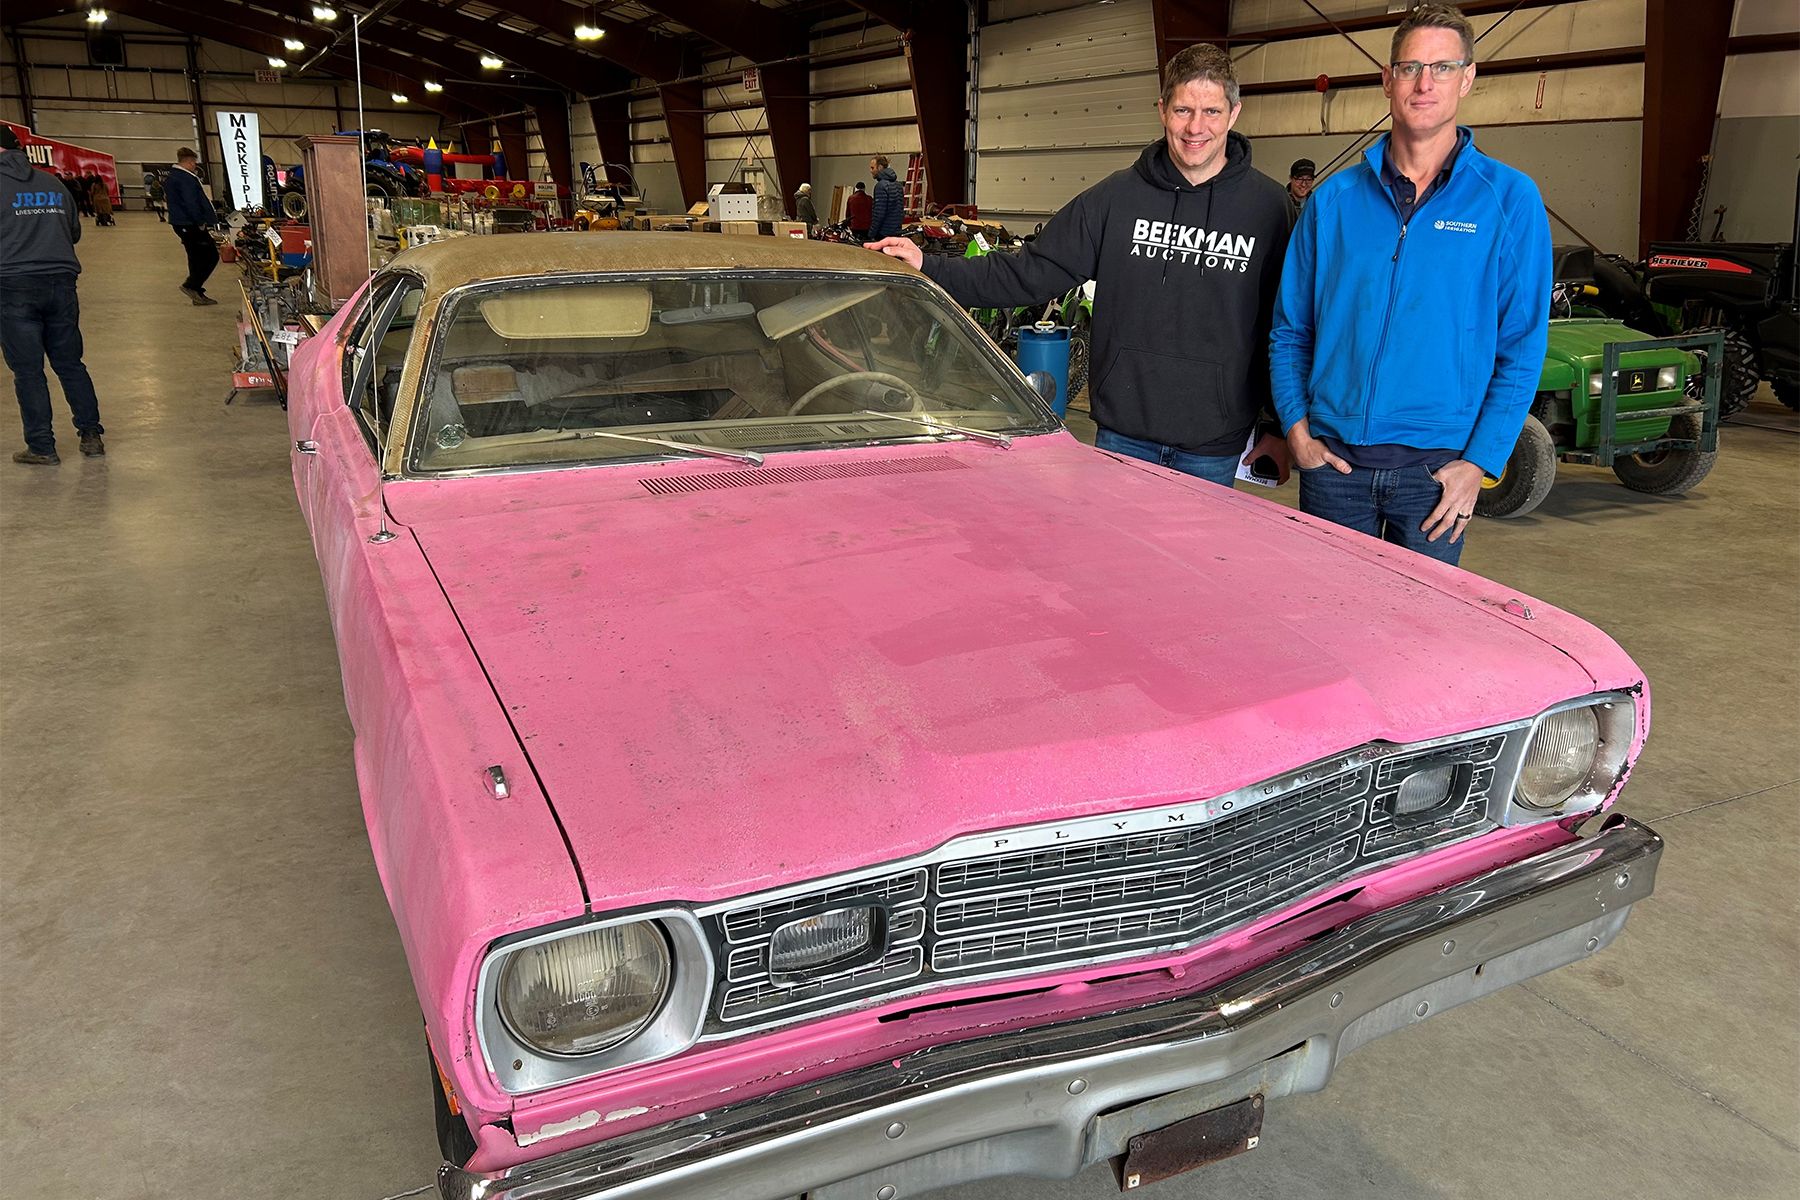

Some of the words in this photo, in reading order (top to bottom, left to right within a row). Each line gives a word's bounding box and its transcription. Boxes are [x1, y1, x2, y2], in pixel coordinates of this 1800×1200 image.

[744, 67, 757, 78] FIRE
[744, 79, 757, 90] EXIT
[25, 145, 54, 167] HUT
[266, 164, 279, 202] ROLLINS
[12, 191, 63, 208] JRDM
[15, 208, 45, 216] LIVESTOCK
[1446, 221, 1477, 229] SOUTHERN
[1132, 218, 1255, 257] BEEKMAN
[1130, 244, 1249, 273] AUCTIONS
[1651, 257, 1709, 269] RETRIEVER
[994, 759, 1350, 848] PLYMOUTH
